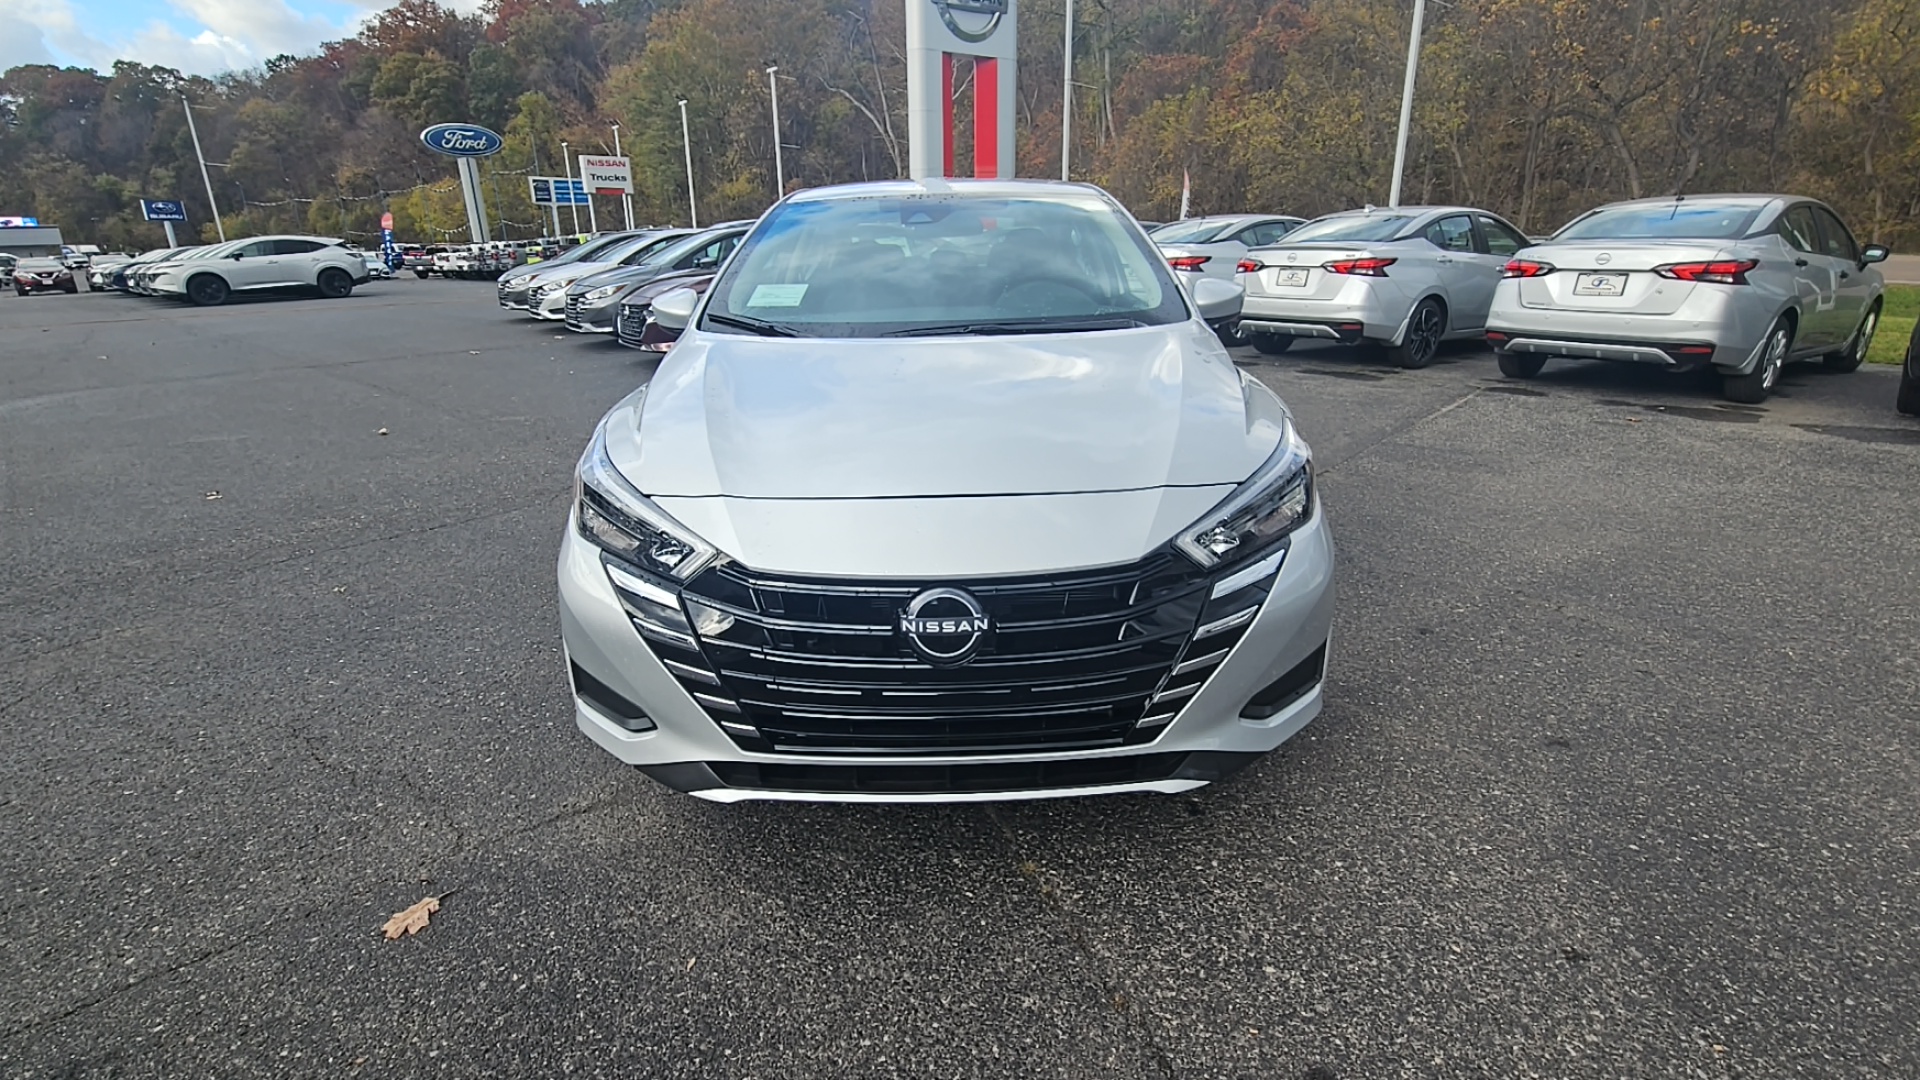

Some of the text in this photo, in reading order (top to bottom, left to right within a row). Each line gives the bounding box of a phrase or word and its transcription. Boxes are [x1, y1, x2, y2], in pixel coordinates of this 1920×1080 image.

[442, 129, 488, 150] Ford
[586, 159, 627, 168] NISSAN
[590, 173, 628, 182] Trucks
[902, 618, 988, 633] NISSAN
